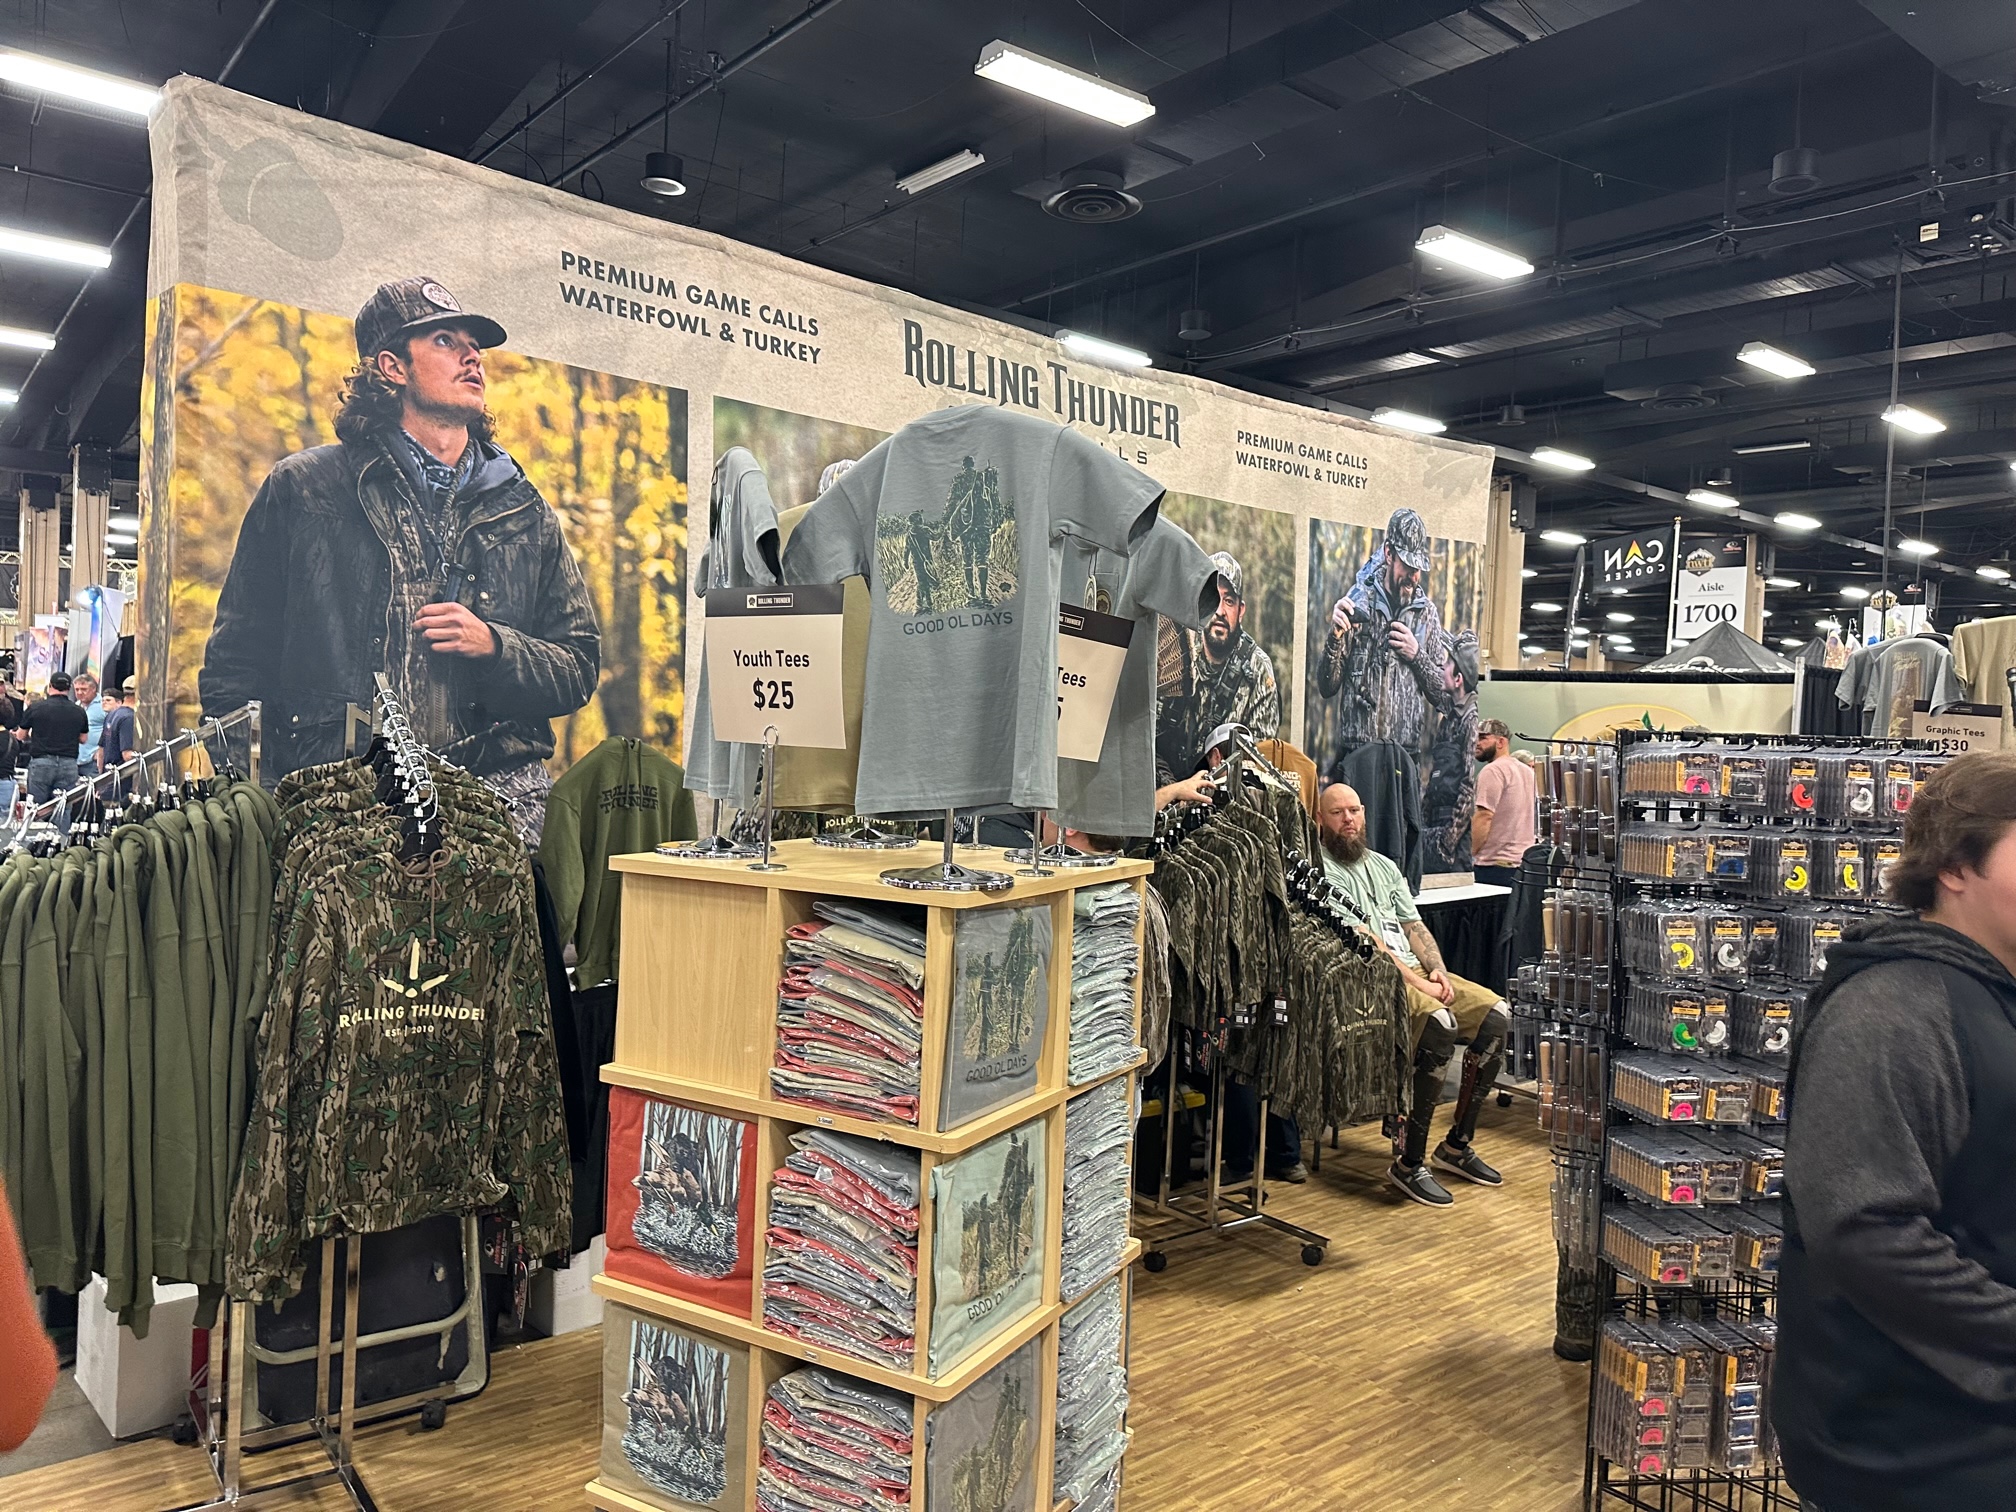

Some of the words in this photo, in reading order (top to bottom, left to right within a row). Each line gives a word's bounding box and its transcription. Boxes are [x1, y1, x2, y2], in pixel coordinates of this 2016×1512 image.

[560, 250, 677, 300] PREMIUM
[685, 284, 751, 318] GAME
[759, 304, 819, 336] CALLS
[559, 281, 711, 337] WATERFOWL
[718, 322, 736, 343] &
[743, 327, 822, 365] TURKEY
[902, 318, 1039, 410] ROLLING
[1046, 360, 1181, 448] THUNDER
[1237, 430, 1294, 455] PREMIUM
[1298, 443, 1332, 463] GAME
[1335, 452, 1368, 470] CALLS
[1235, 450, 1310, 479] WATERFOWL
[1313, 467, 1323, 481] &
[1326, 470, 1368, 490] TURKEY
[1697, 582, 1724, 592] Aisle
[902, 618, 944, 636] GOOD
[971, 611, 1013, 627] DAYS
[1684, 603, 1737, 623] 1700
[733, 649, 772, 667] Youth
[775, 649, 810, 667] Tees
[752, 677, 794, 711] $25
[1925, 725, 1961, 736] Graphic
[1963, 728, 1985, 738] Tees
[1941, 737, 1969, 752] $30
[411, 1024, 435, 1035] 2010
[965, 1064, 993, 1083] GOOD
[1007, 1054, 1028, 1071] DAYS
[967, 1298, 993, 1320] GOOD
